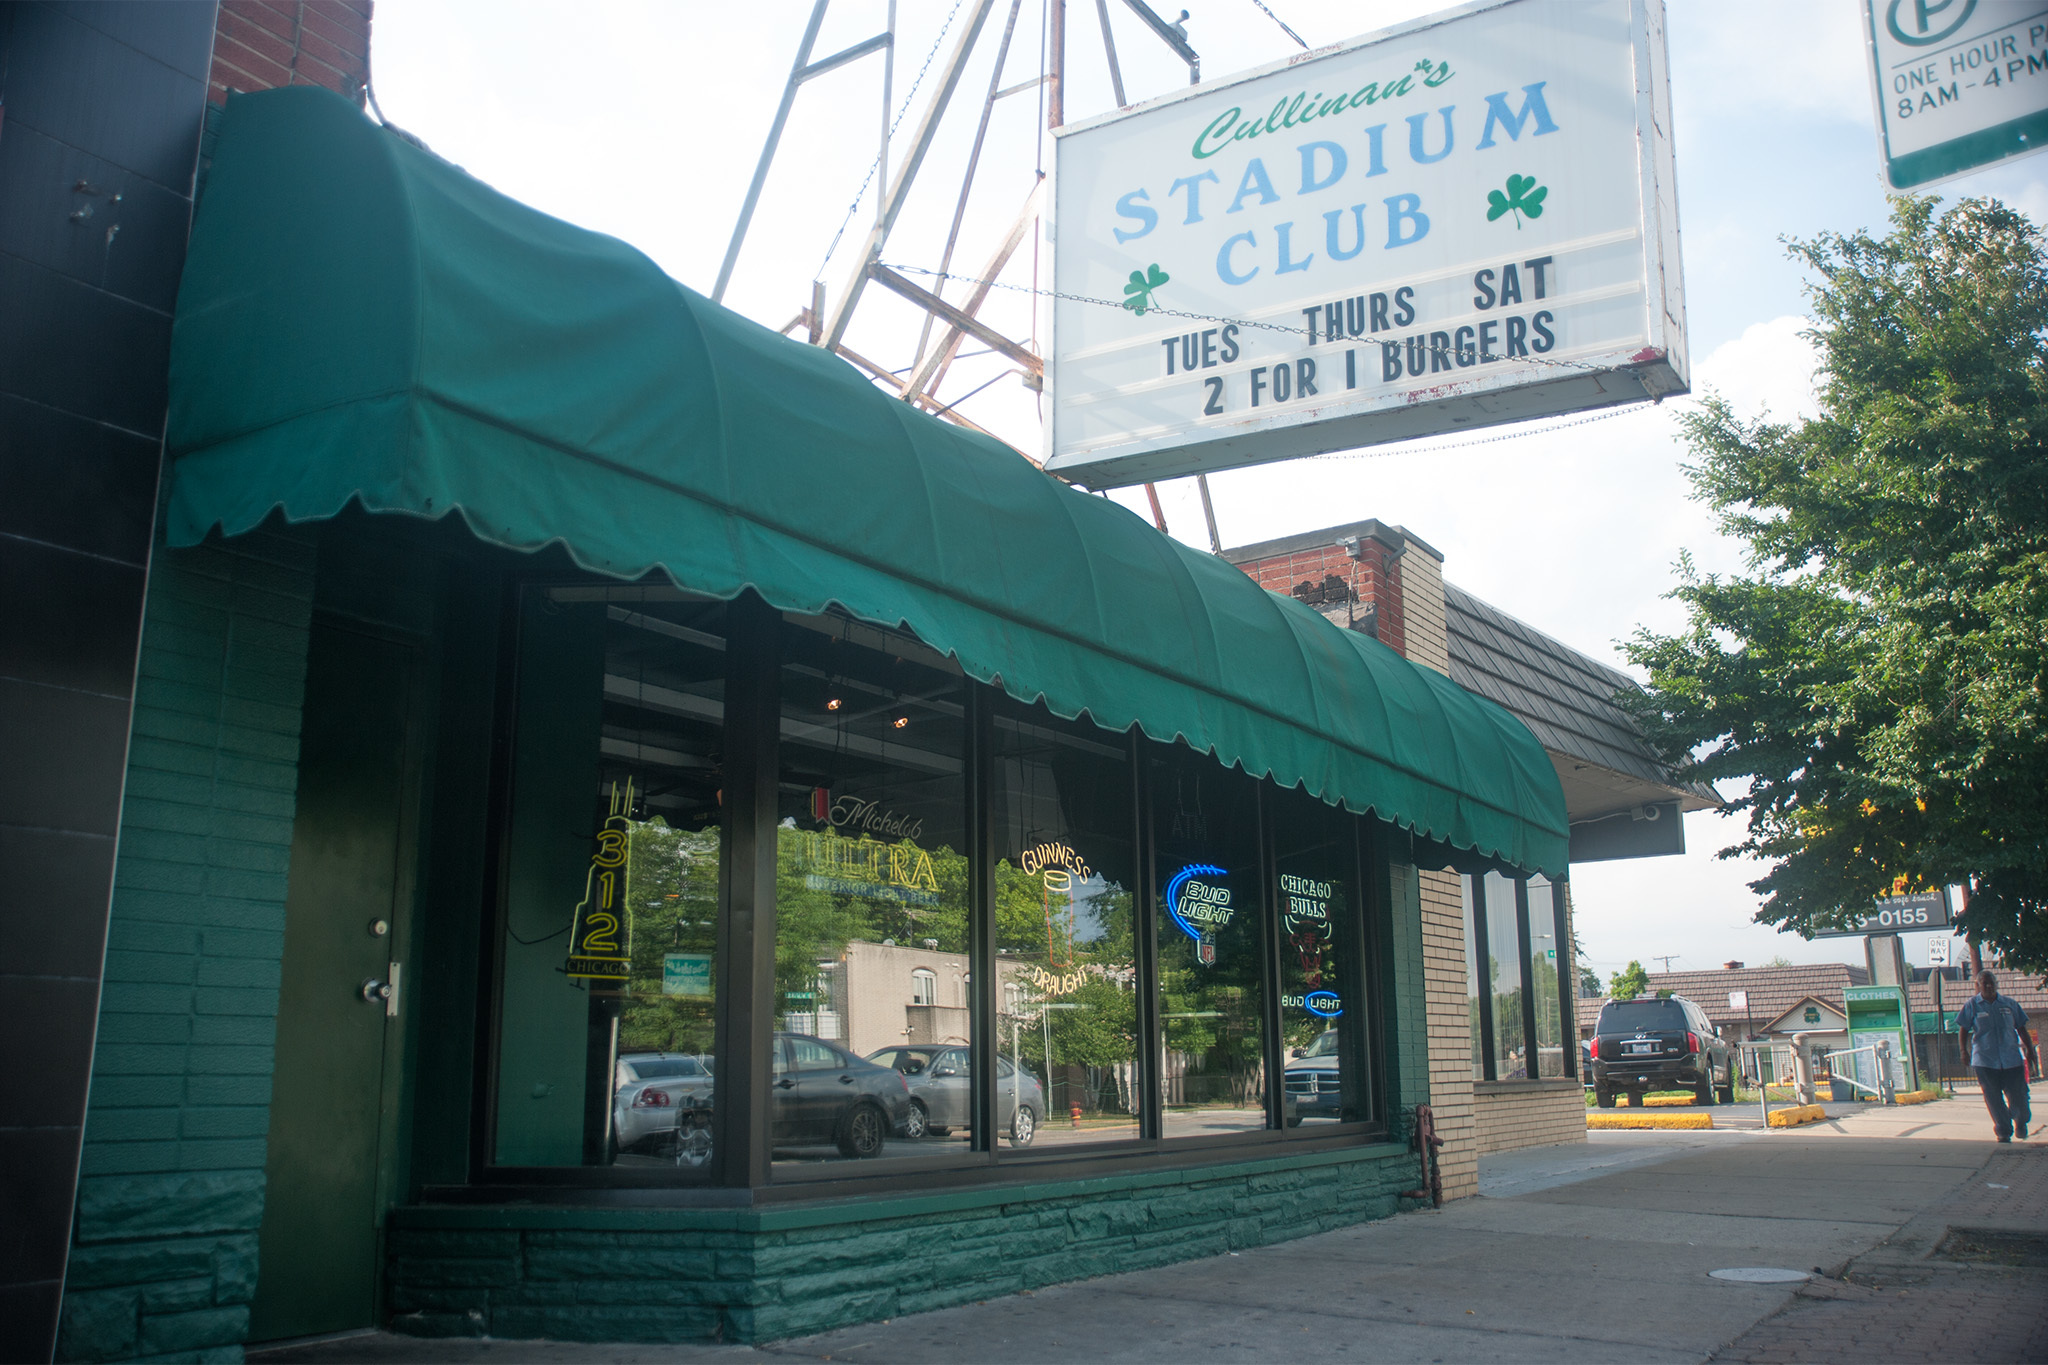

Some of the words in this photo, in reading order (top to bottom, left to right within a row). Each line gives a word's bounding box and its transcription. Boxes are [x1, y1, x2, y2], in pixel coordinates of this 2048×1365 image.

[1894, 63, 1939, 94] ONE
[1950, 35, 2017, 75] HOUR
[2029, 24, 2048, 47] P
[1192, 58, 1456, 159] Cullinan's
[1113, 81, 1560, 244] STADIUM
[1215, 193, 1431, 286] CLUB
[1162, 324, 1239, 375] TUES
[1302, 286, 1415, 346] THURS
[1473, 255, 1553, 311] SAT
[1203, 376, 1224, 416] 2
[1251, 358, 1318, 407] FOR
[1382, 310, 1555, 382] BURGERS
[829, 795, 923, 840] Michelob
[804, 829, 939, 892] ULTRA
[1021, 842, 1091, 885] GUINNESS
[1185, 880, 1231, 905] BUD
[1281, 874, 1331, 898] CHICAGO
[1177, 896, 1234, 924] LIGHT
[1290, 896, 1326, 918] BULLS
[566, 961, 630, 975] CHICAGO
[1202, 945, 1215, 962] NFL
[1033, 965, 1088, 996] DRAUGHT
[1847, 991, 1897, 1001] CLOTHES
[1281, 995, 1305, 1007] BUD
[1310, 998, 1341, 1010] LIGHT
